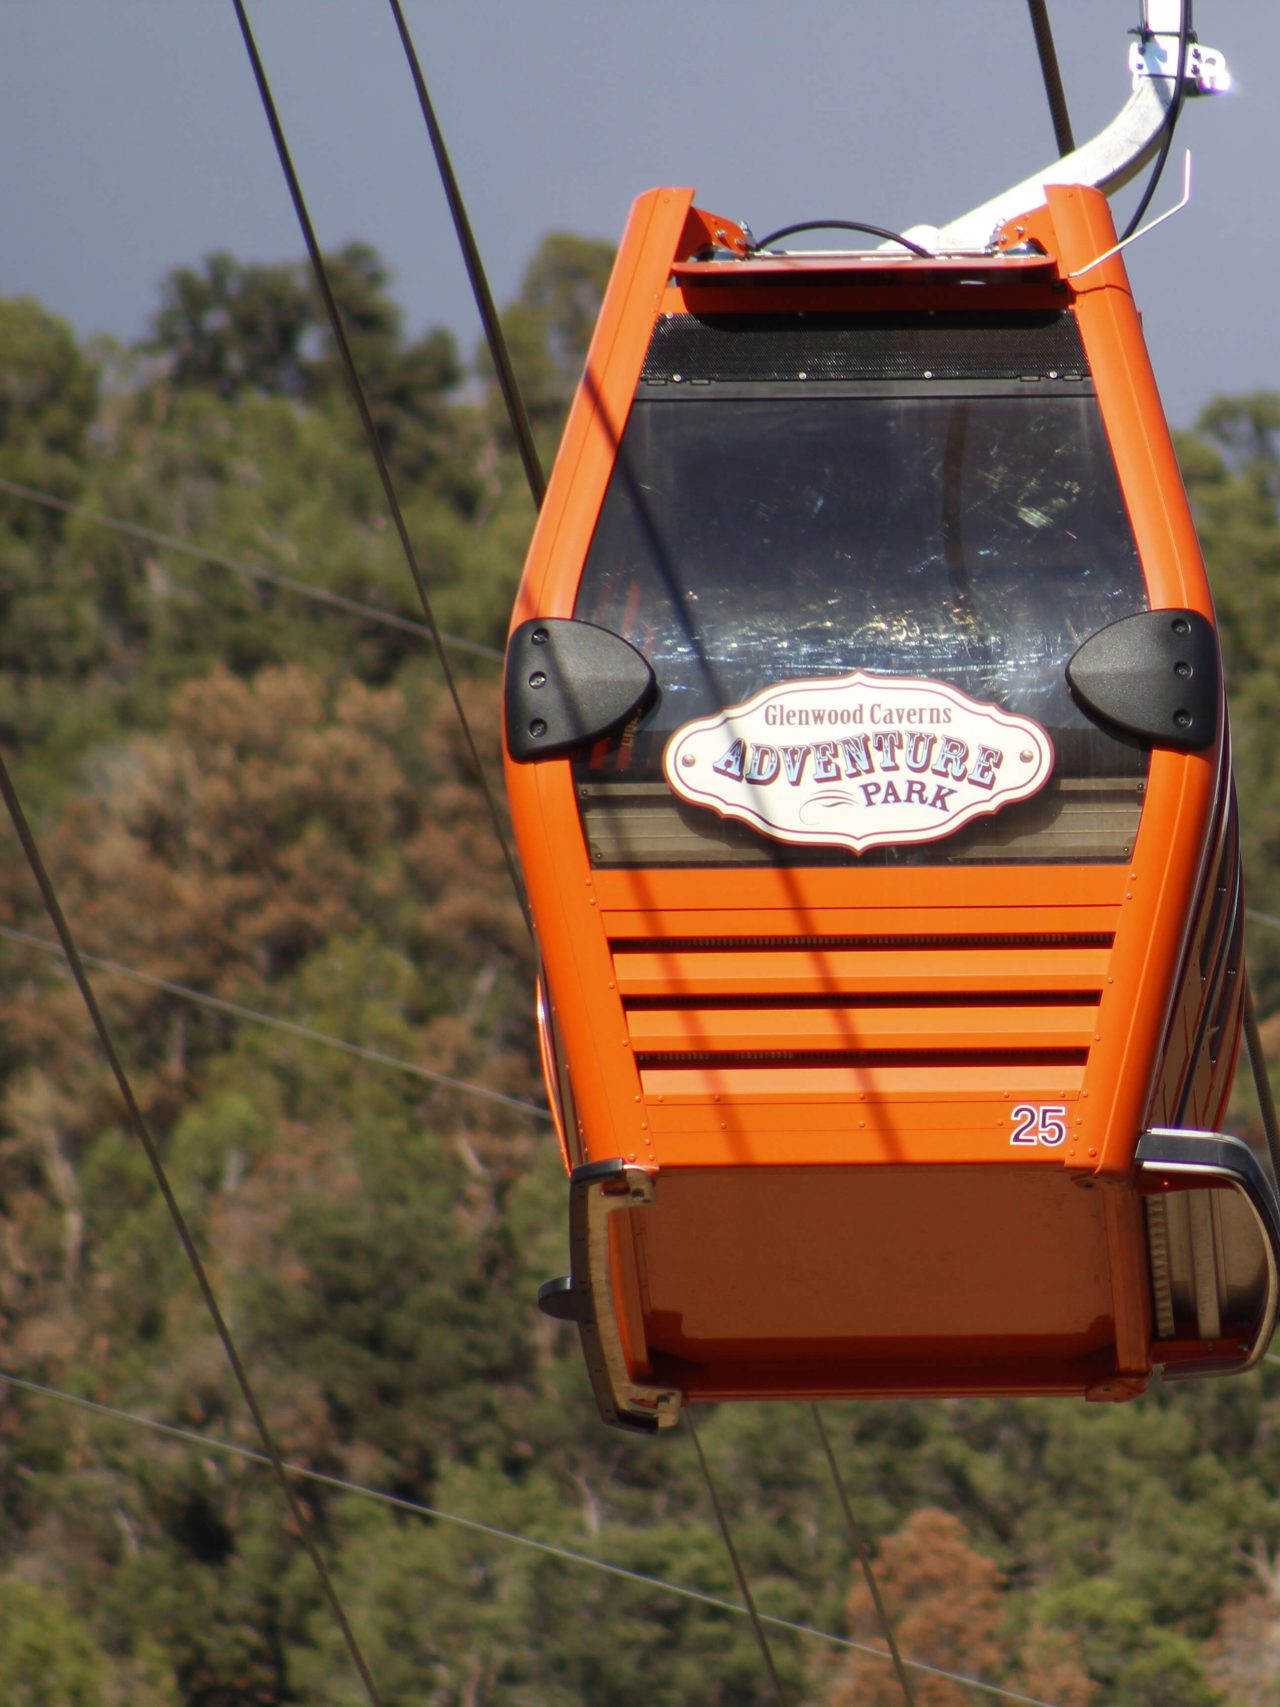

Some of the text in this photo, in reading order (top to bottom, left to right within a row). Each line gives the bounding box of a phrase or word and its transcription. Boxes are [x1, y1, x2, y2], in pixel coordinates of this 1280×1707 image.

[764, 703, 952, 725] Glenwood Caverns
[712, 731, 1003, 790] ADVENTURE
[859, 779, 958, 812] PARK
[1009, 1104, 1067, 1147] 25
